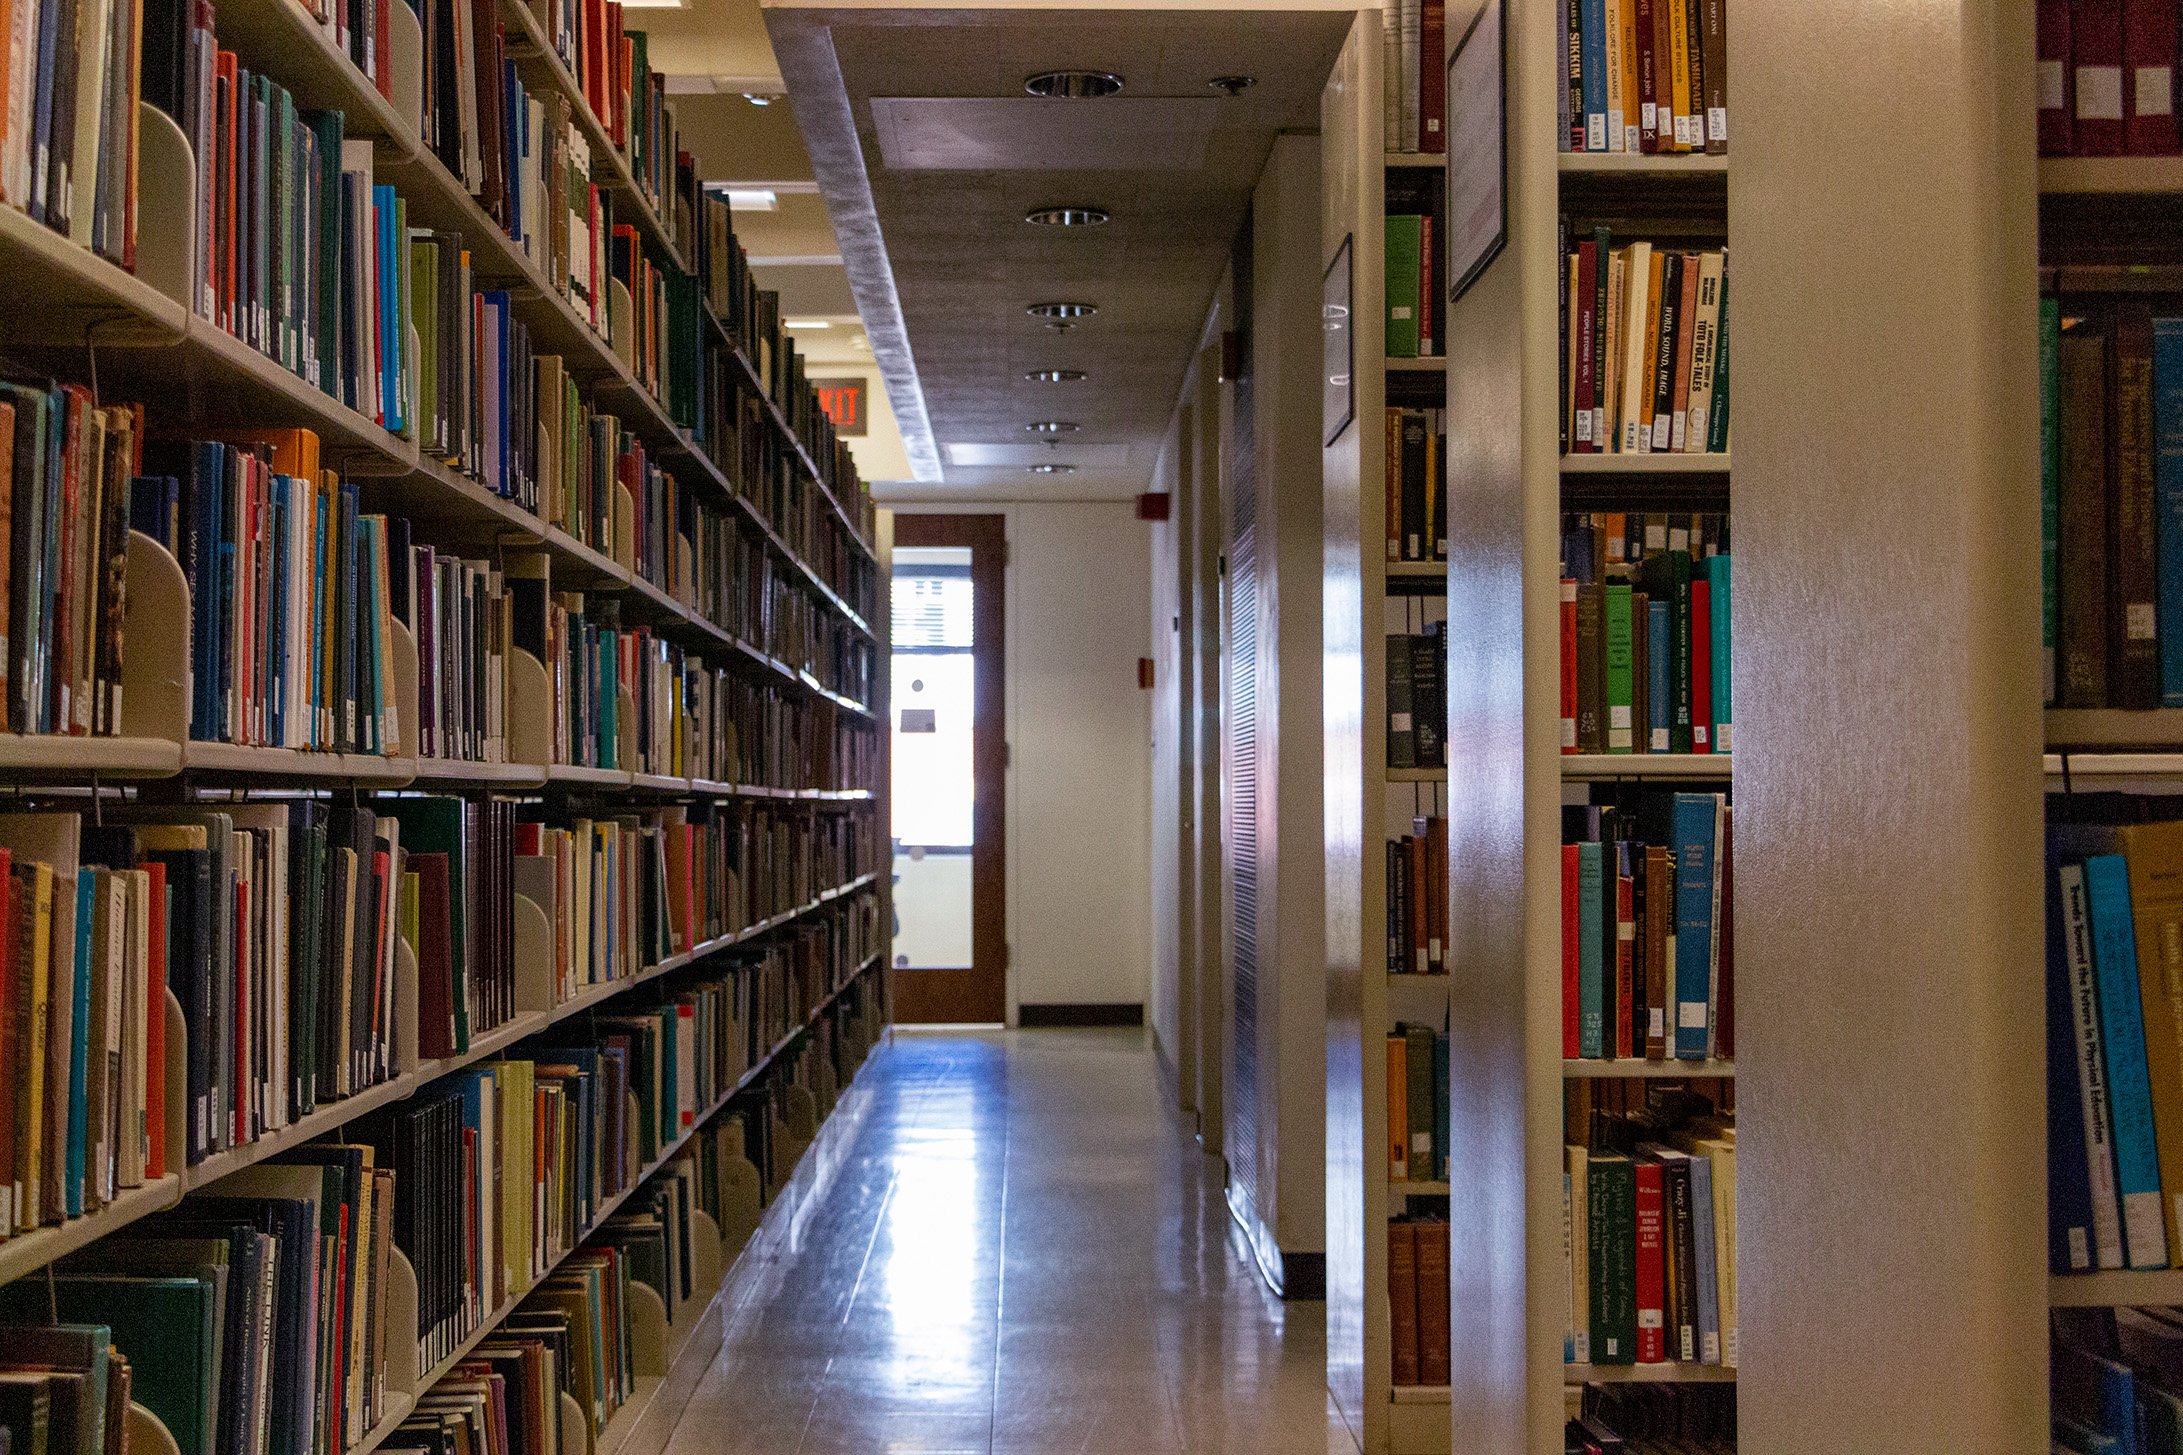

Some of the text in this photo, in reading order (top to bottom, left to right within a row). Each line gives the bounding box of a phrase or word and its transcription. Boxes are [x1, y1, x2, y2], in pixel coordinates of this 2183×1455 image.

[1570, 32, 1580, 79] SIKKIM
[1643, 80, 1651, 95] John
[1659, 306, 1673, 396] WORD, SOUND, IMAGE
[1692, 320, 1707, 392] TOTO FOLK-TALES
[818, 388, 859, 420] XIT
[189, 531, 198, 567] WHY
[188, 571, 197, 599] SEX
[2166, 923, 2179, 964] Health
[112, 892, 123, 1046] Human Evolution
[2170, 969, 2182, 993] and
[2070, 884, 2104, 1144] Trends Toward the Future in Physical Education
[1674, 1179, 1687, 1219] Crazy Ji
[263, 1258, 273, 1351] THE LINK
